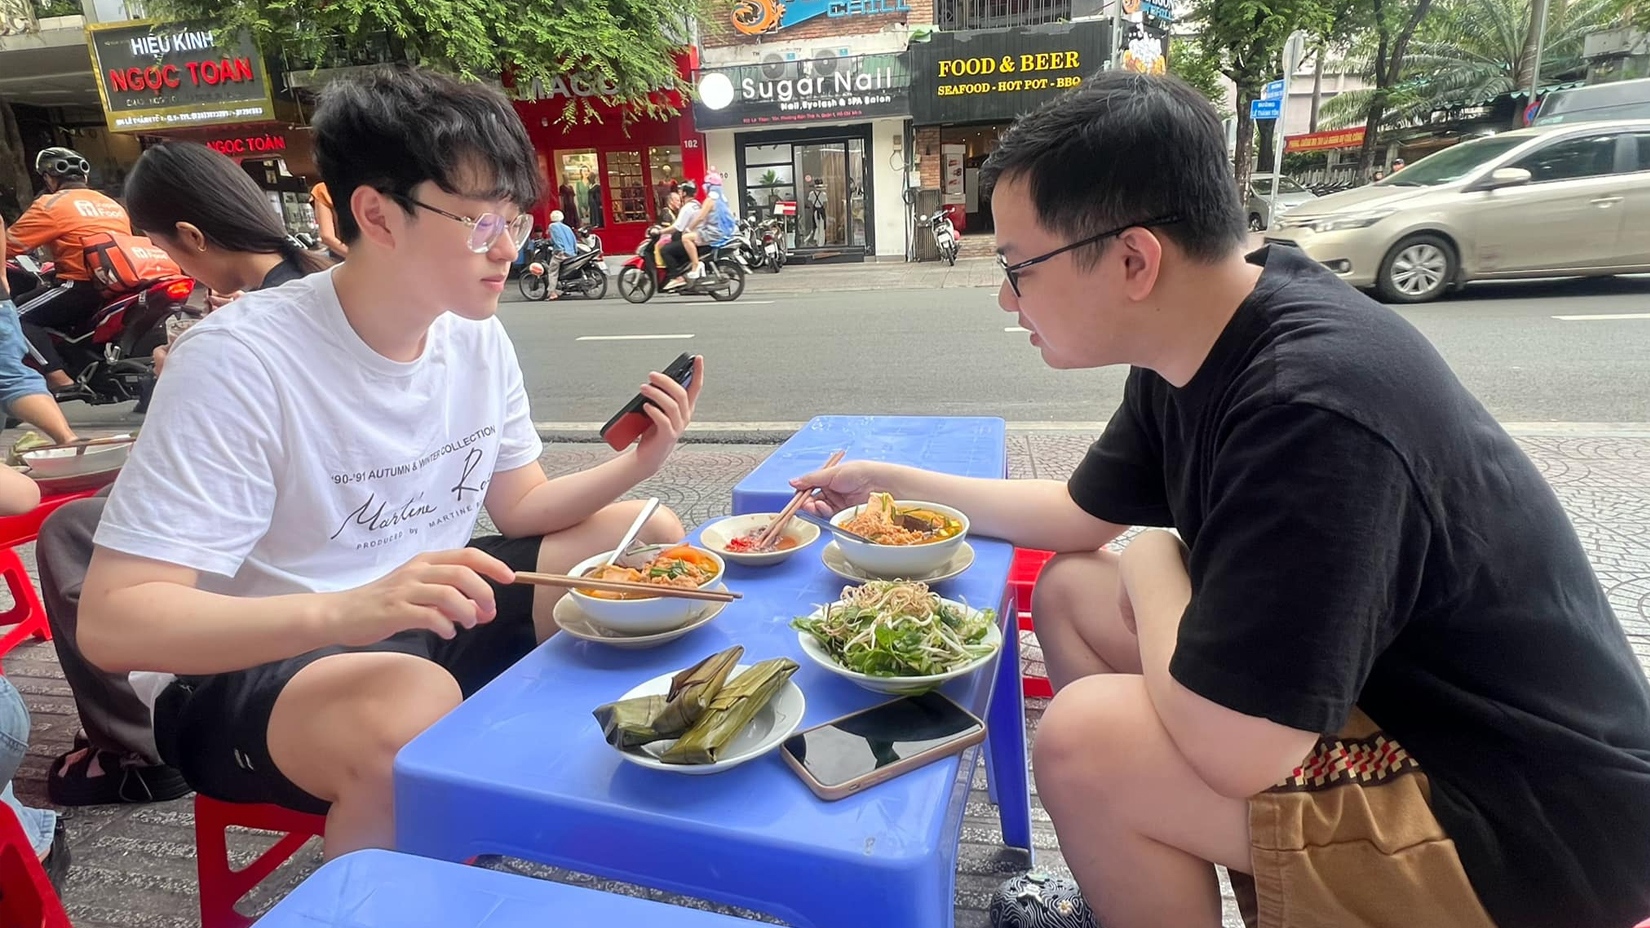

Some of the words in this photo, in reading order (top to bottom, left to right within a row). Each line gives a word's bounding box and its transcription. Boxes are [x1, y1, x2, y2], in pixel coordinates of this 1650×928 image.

[108, 64, 181, 96] NGỌC
[185, 54, 254, 86] TOÀN
[938, 57, 996, 77] FOOD
[999, 55, 1016, 73] &
[1020, 51, 1080, 72] BEER
[742, 76, 825, 102] Sugar
[834, 66, 891, 93] Nail
[938, 83, 990, 96] SEAFOOD
[998, 81, 1023, 92] HOT
[1024, 79, 1048, 90] POT
[1057, 76, 1081, 89] BBQ
[848, 96, 863, 106] SPA
[246, 134, 286, 151] TOÀN
[683, 140, 698, 148] 102
[368, 463, 411, 480] AUTUMN
[412, 461, 418, 472] &
[419, 450, 440, 469] WINTER
[440, 425, 496, 456] COLLECTION
[356, 531, 404, 550] PRODUCED
[409, 527, 418, 535] by
[429, 504, 473, 528] MARTINE
